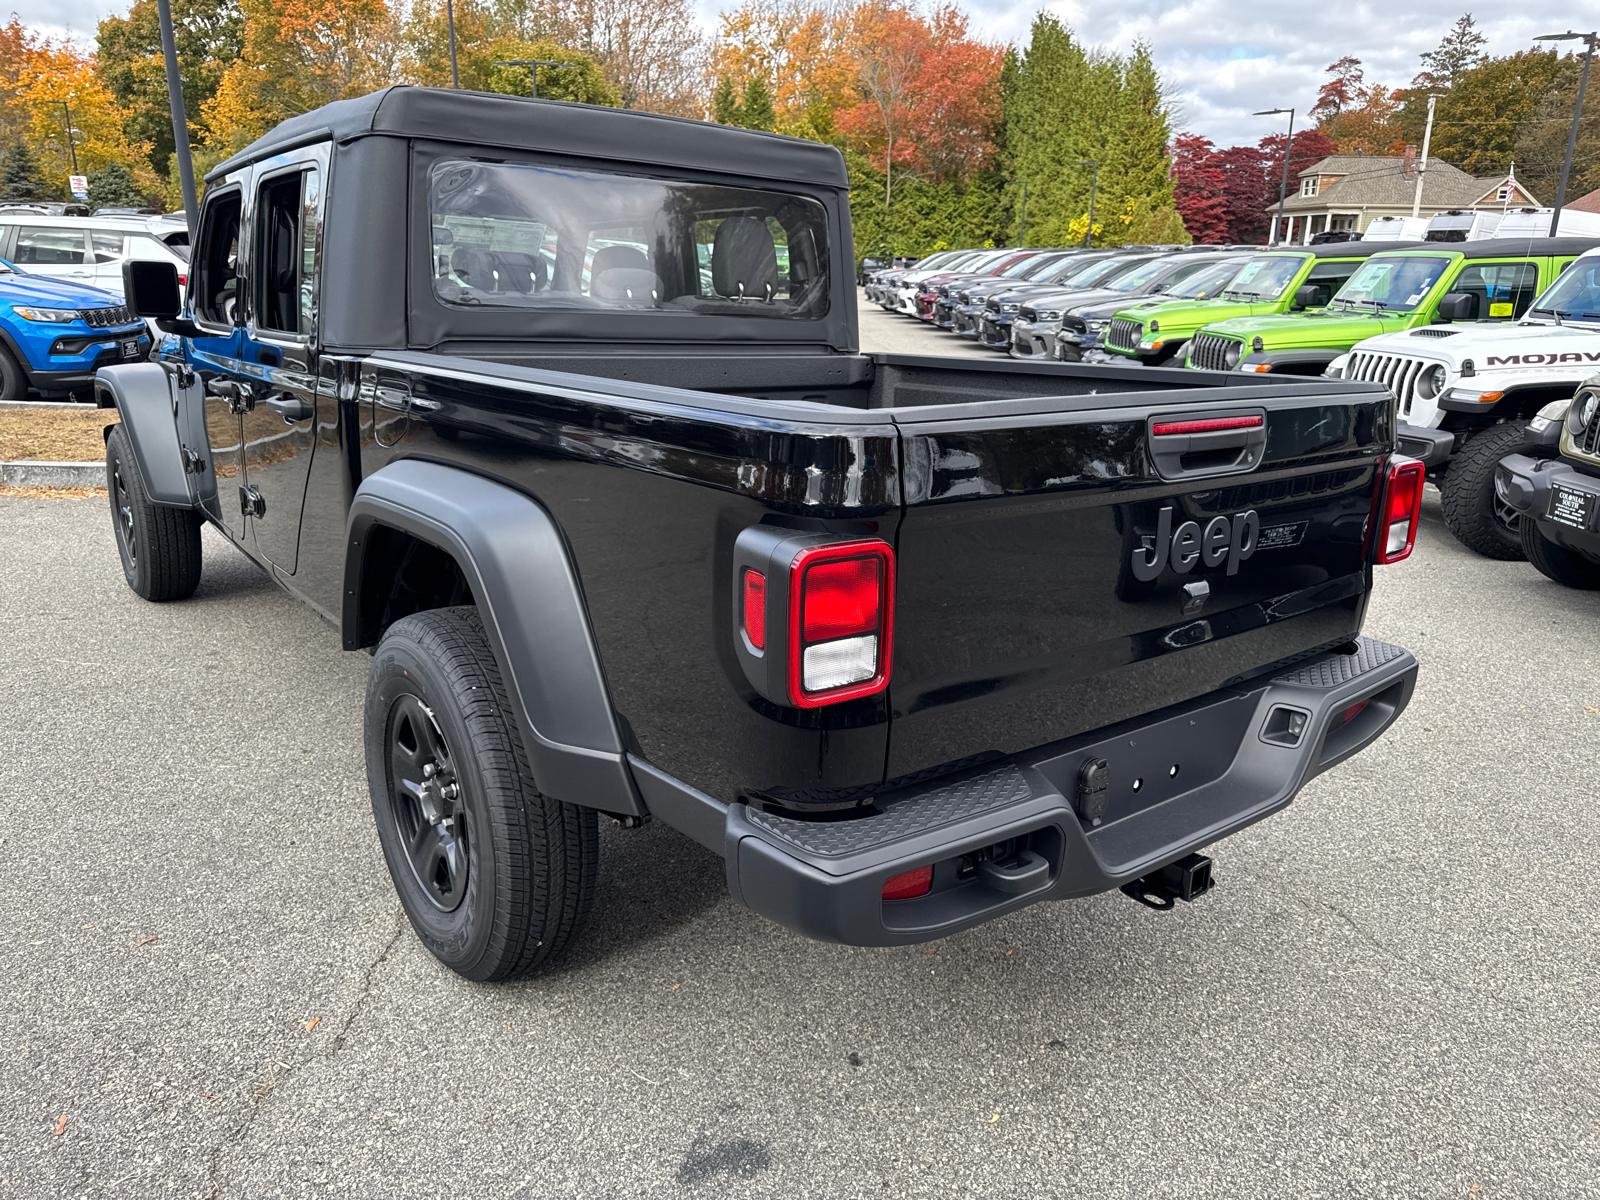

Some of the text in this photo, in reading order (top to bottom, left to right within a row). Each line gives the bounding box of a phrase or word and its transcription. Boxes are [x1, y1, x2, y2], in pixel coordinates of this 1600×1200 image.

[1559, 492, 1585, 505] COLONIAL
[1562, 498, 1579, 509] SOUTH
[1131, 506, 1260, 582] Jeep
